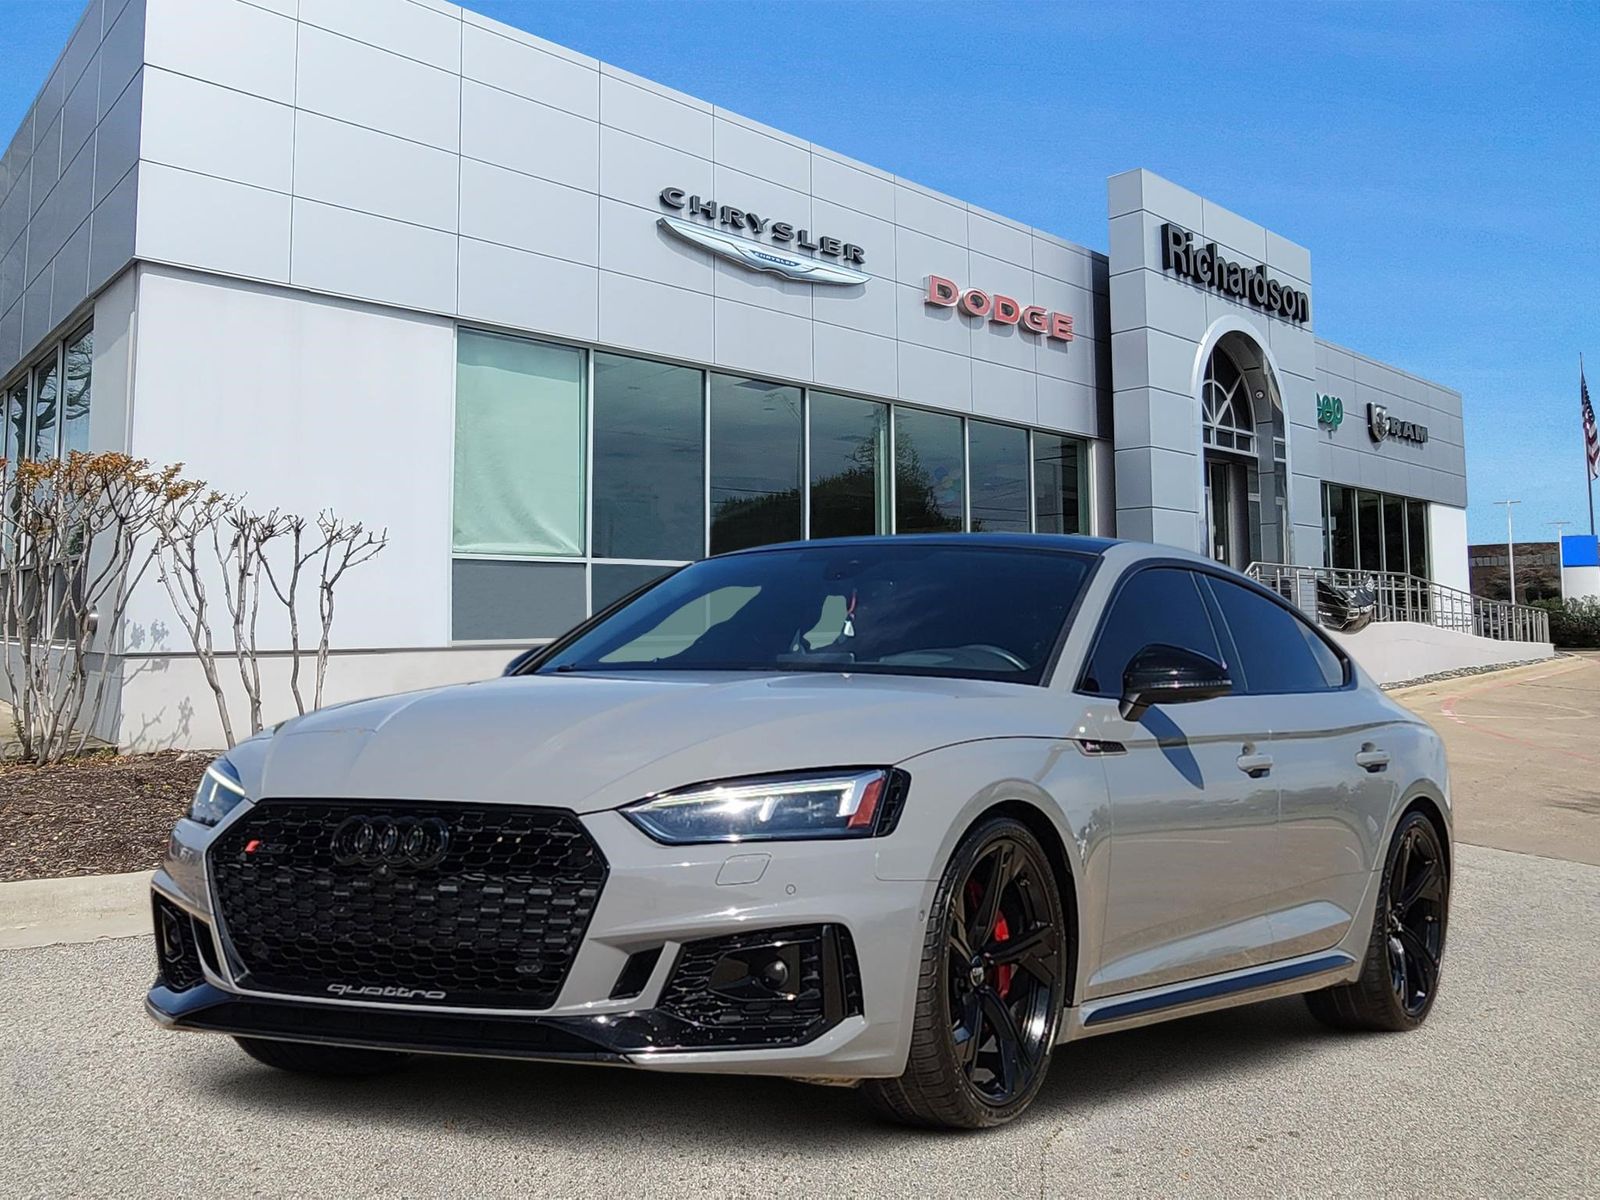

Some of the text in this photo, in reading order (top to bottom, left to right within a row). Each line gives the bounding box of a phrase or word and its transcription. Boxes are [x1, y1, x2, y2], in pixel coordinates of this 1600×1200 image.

[660, 187, 866, 263] CHRYSLER
[1161, 223, 1309, 322] Richardson
[925, 274, 1073, 341] DODGE
[1388, 416, 1429, 443] RAM
[326, 983, 447, 1000] quattro
